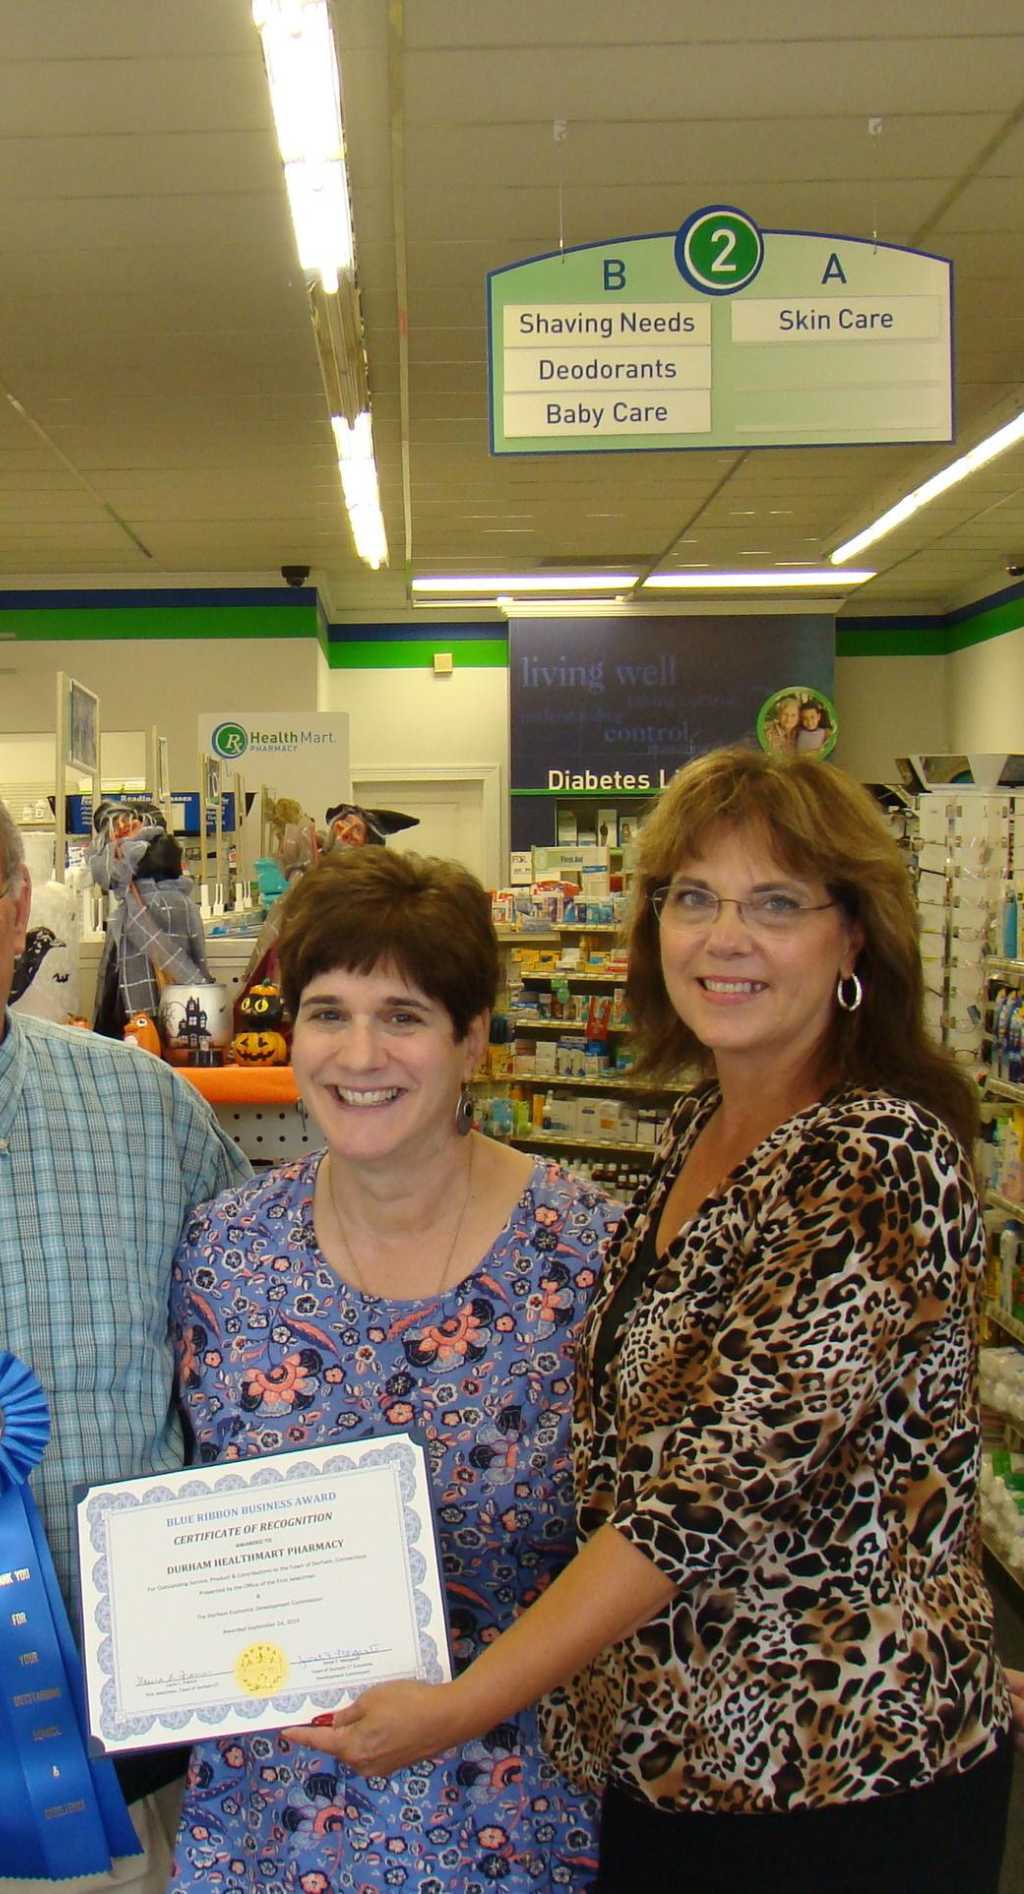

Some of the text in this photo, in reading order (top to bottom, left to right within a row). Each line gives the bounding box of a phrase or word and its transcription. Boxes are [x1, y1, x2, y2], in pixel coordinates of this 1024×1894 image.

[711, 229, 737, 272] 2
[604, 259, 627, 291] B
[821, 253, 847, 285] A
[520, 312, 695, 338] Shaving Needs
[779, 309, 893, 331] Skin Care
[539, 359, 677, 381] Deodorants
[546, 403, 668, 428] Baby Care
[521, 654, 677, 694] living well
[548, 769, 650, 790] Diabetes
[167, 1491, 336, 1529] BLUE RIBBON BUSINESS AWARD
[174, 1511, 333, 1546] CERTIFICATE OF RECOGNITION
[167, 1539, 344, 1575] DURHAM HEALTHMART PHARMACY
